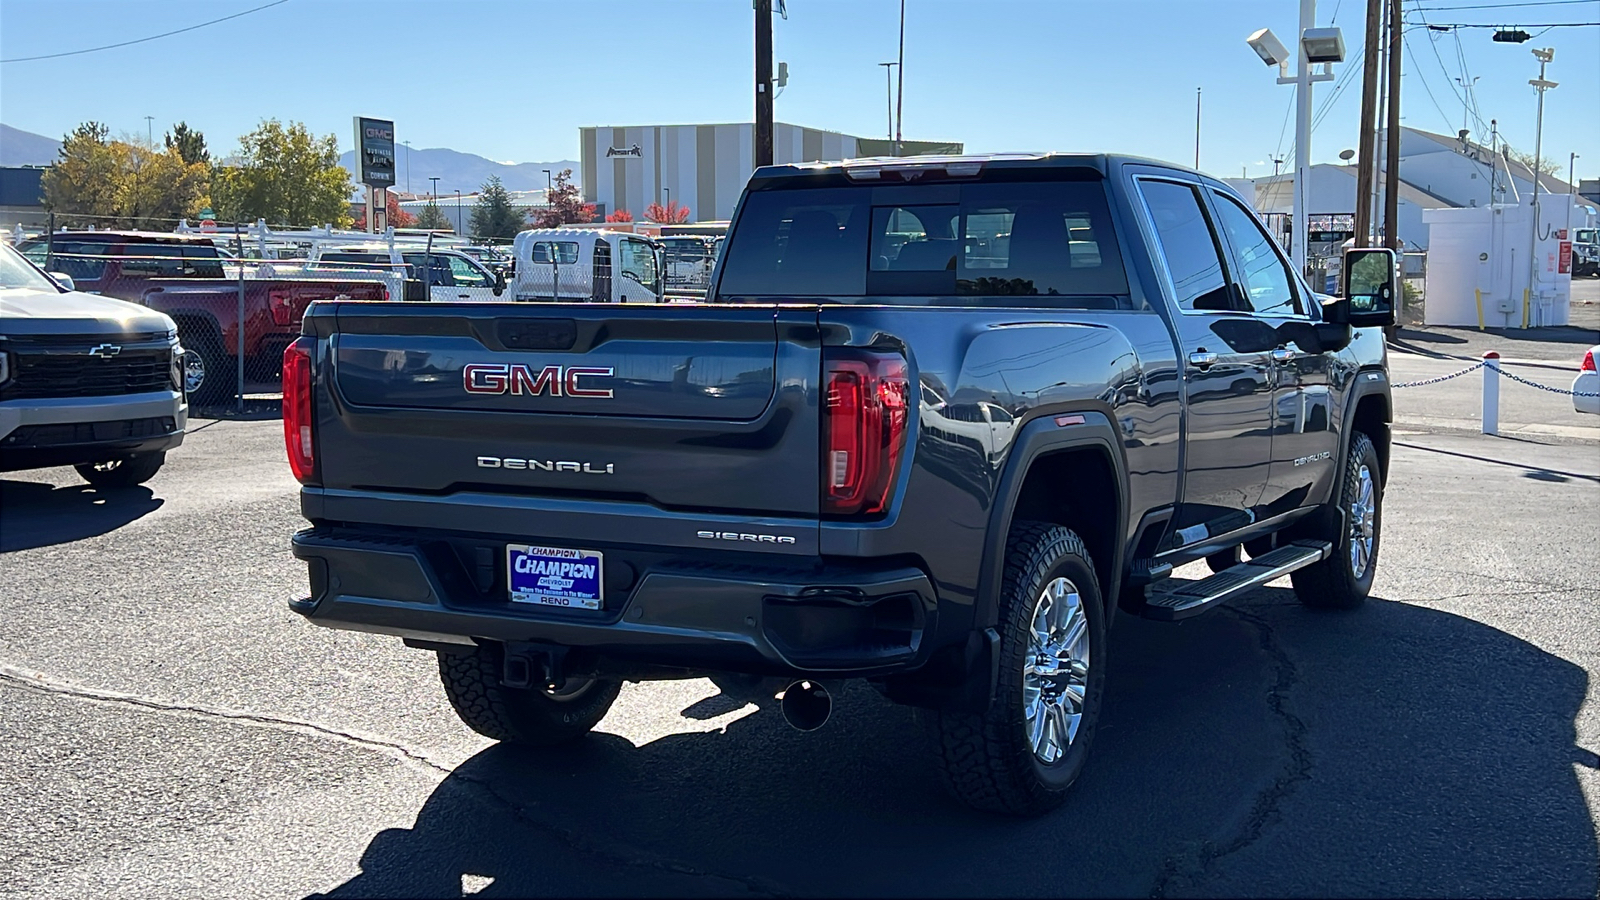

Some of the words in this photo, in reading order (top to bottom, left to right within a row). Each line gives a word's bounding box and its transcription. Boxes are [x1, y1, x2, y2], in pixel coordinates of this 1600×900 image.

[366, 128, 392, 139] GMC
[463, 363, 614, 399] GMC
[477, 456, 614, 475] DENALI
[697, 530, 796, 545] SIERRA
[532, 548, 576, 558] CHAMPION
[540, 579, 572, 587] CHEVROLET
[541, 597, 570, 606] RENO
